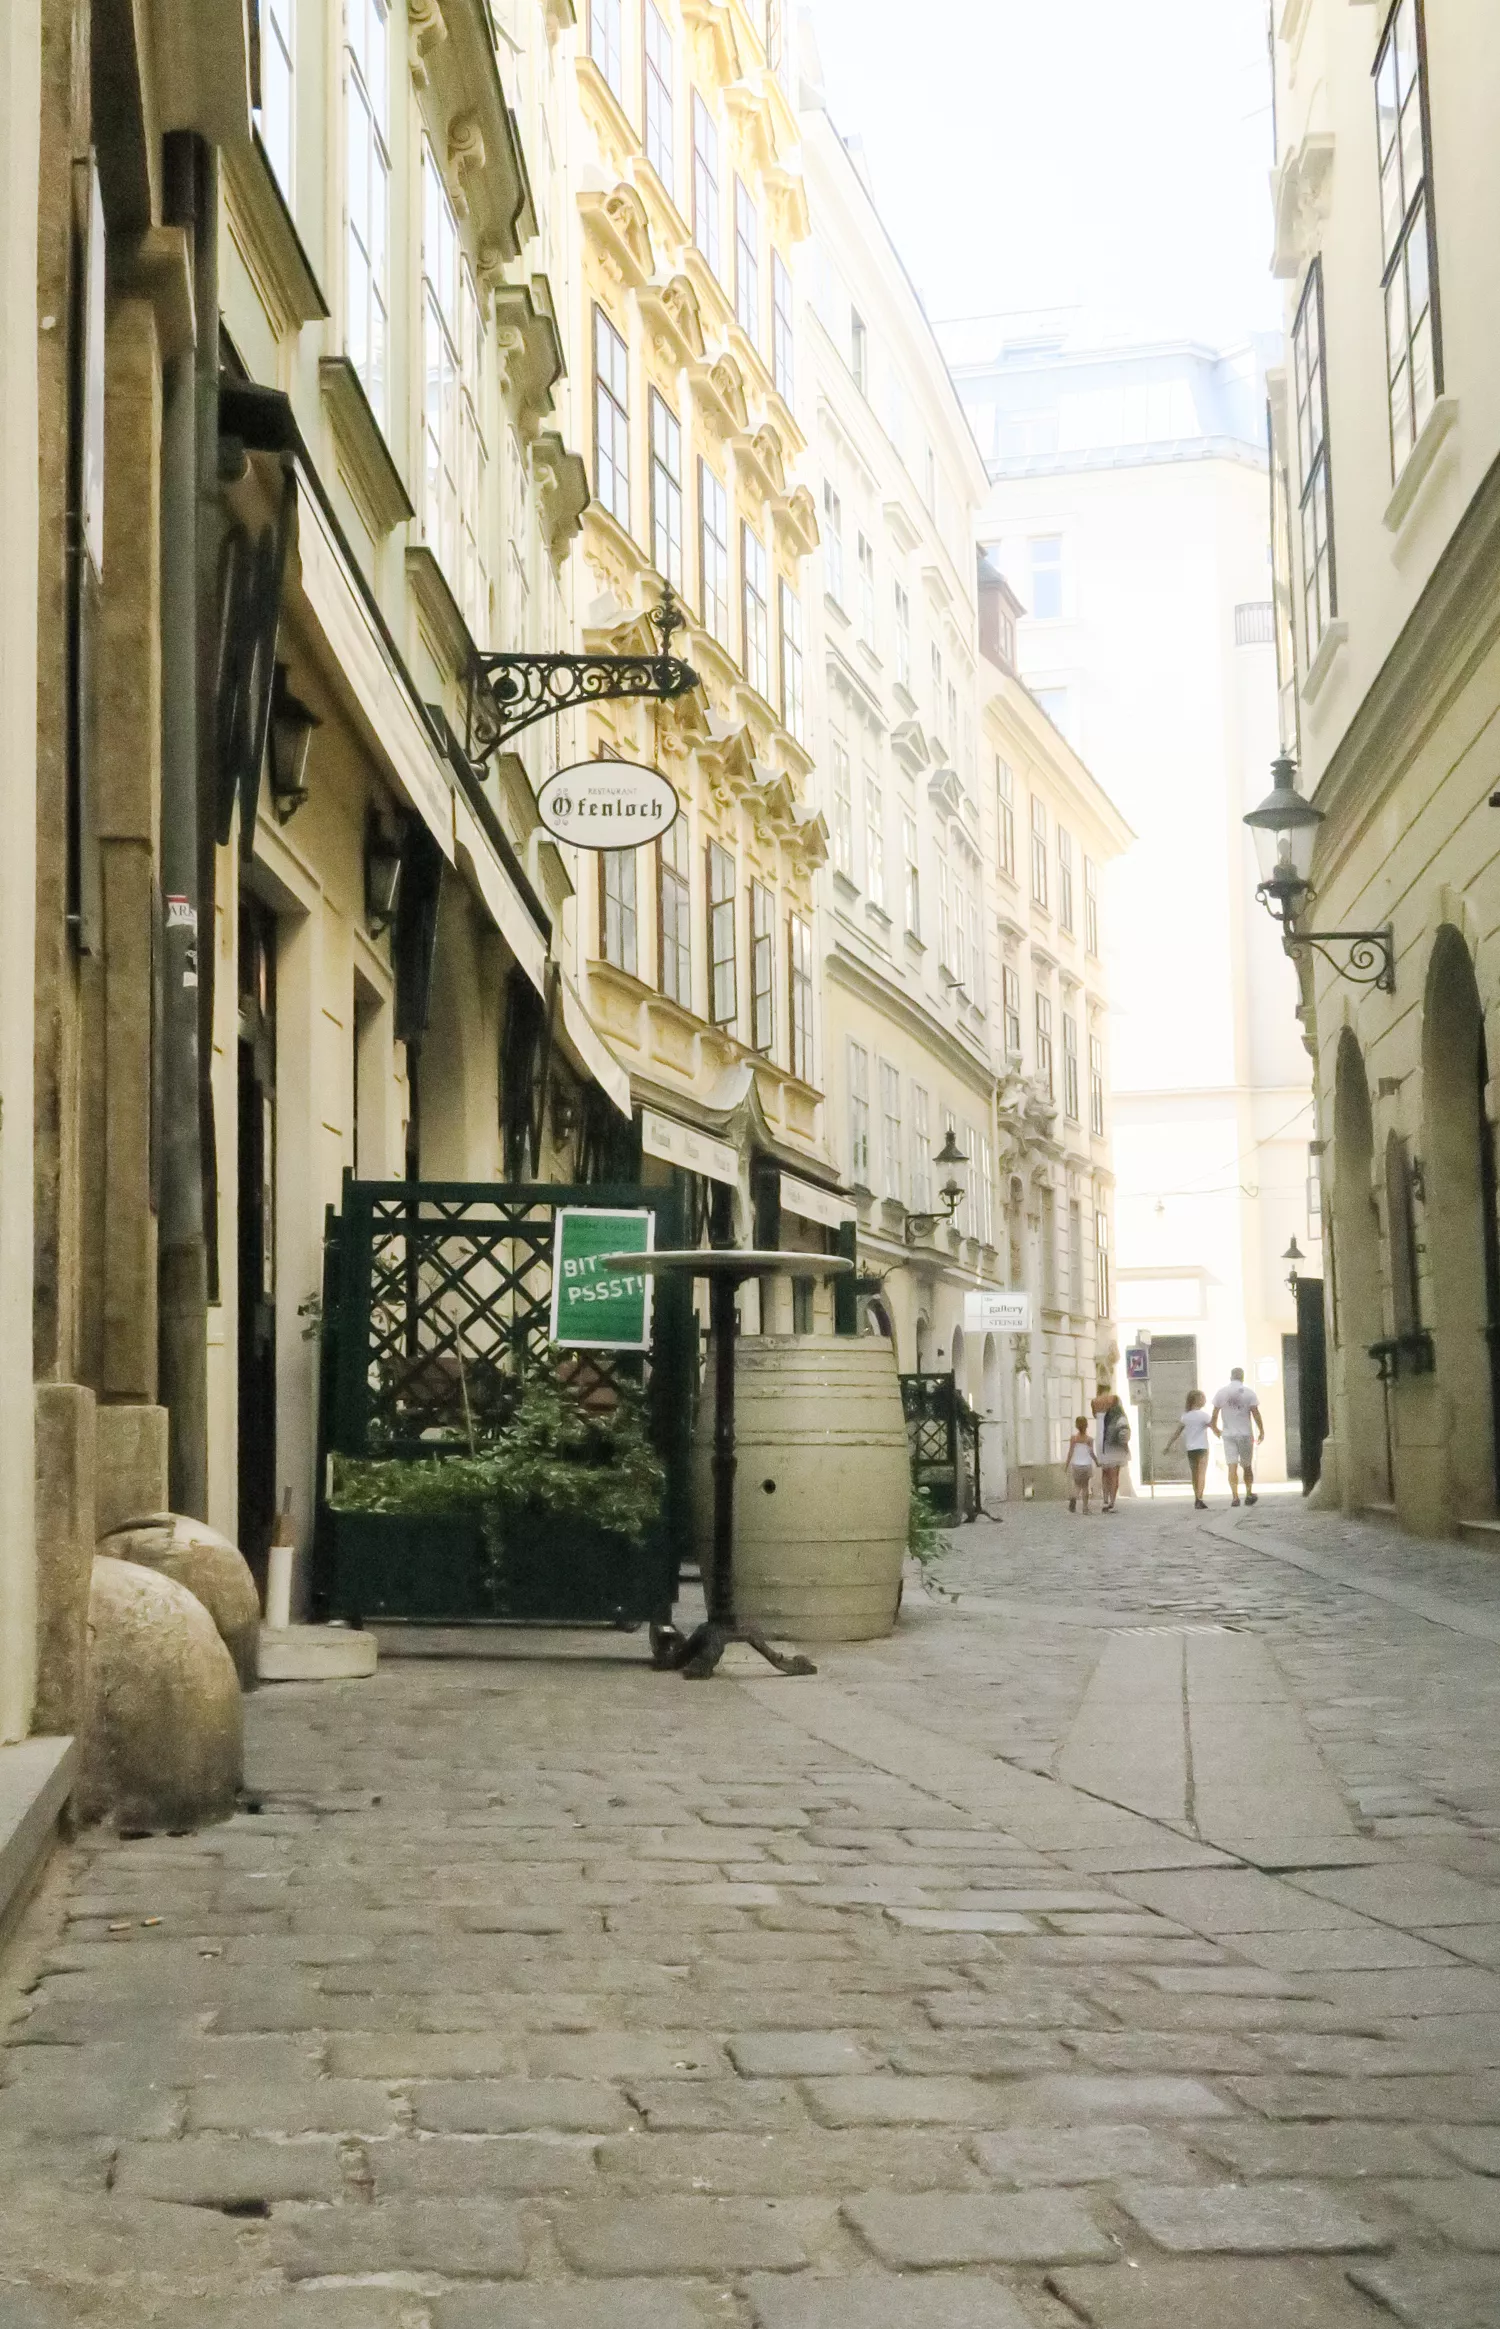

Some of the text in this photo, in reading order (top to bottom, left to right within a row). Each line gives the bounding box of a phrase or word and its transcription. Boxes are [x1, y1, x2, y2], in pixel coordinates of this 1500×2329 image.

[587, 787, 637, 796] RESTAURANT
[550, 796, 662, 820] Ofenloch
[563, 1251, 625, 1278] BIT
[567, 1275, 644, 1305] PSSST!
[989, 1305, 1023, 1314] gallery
